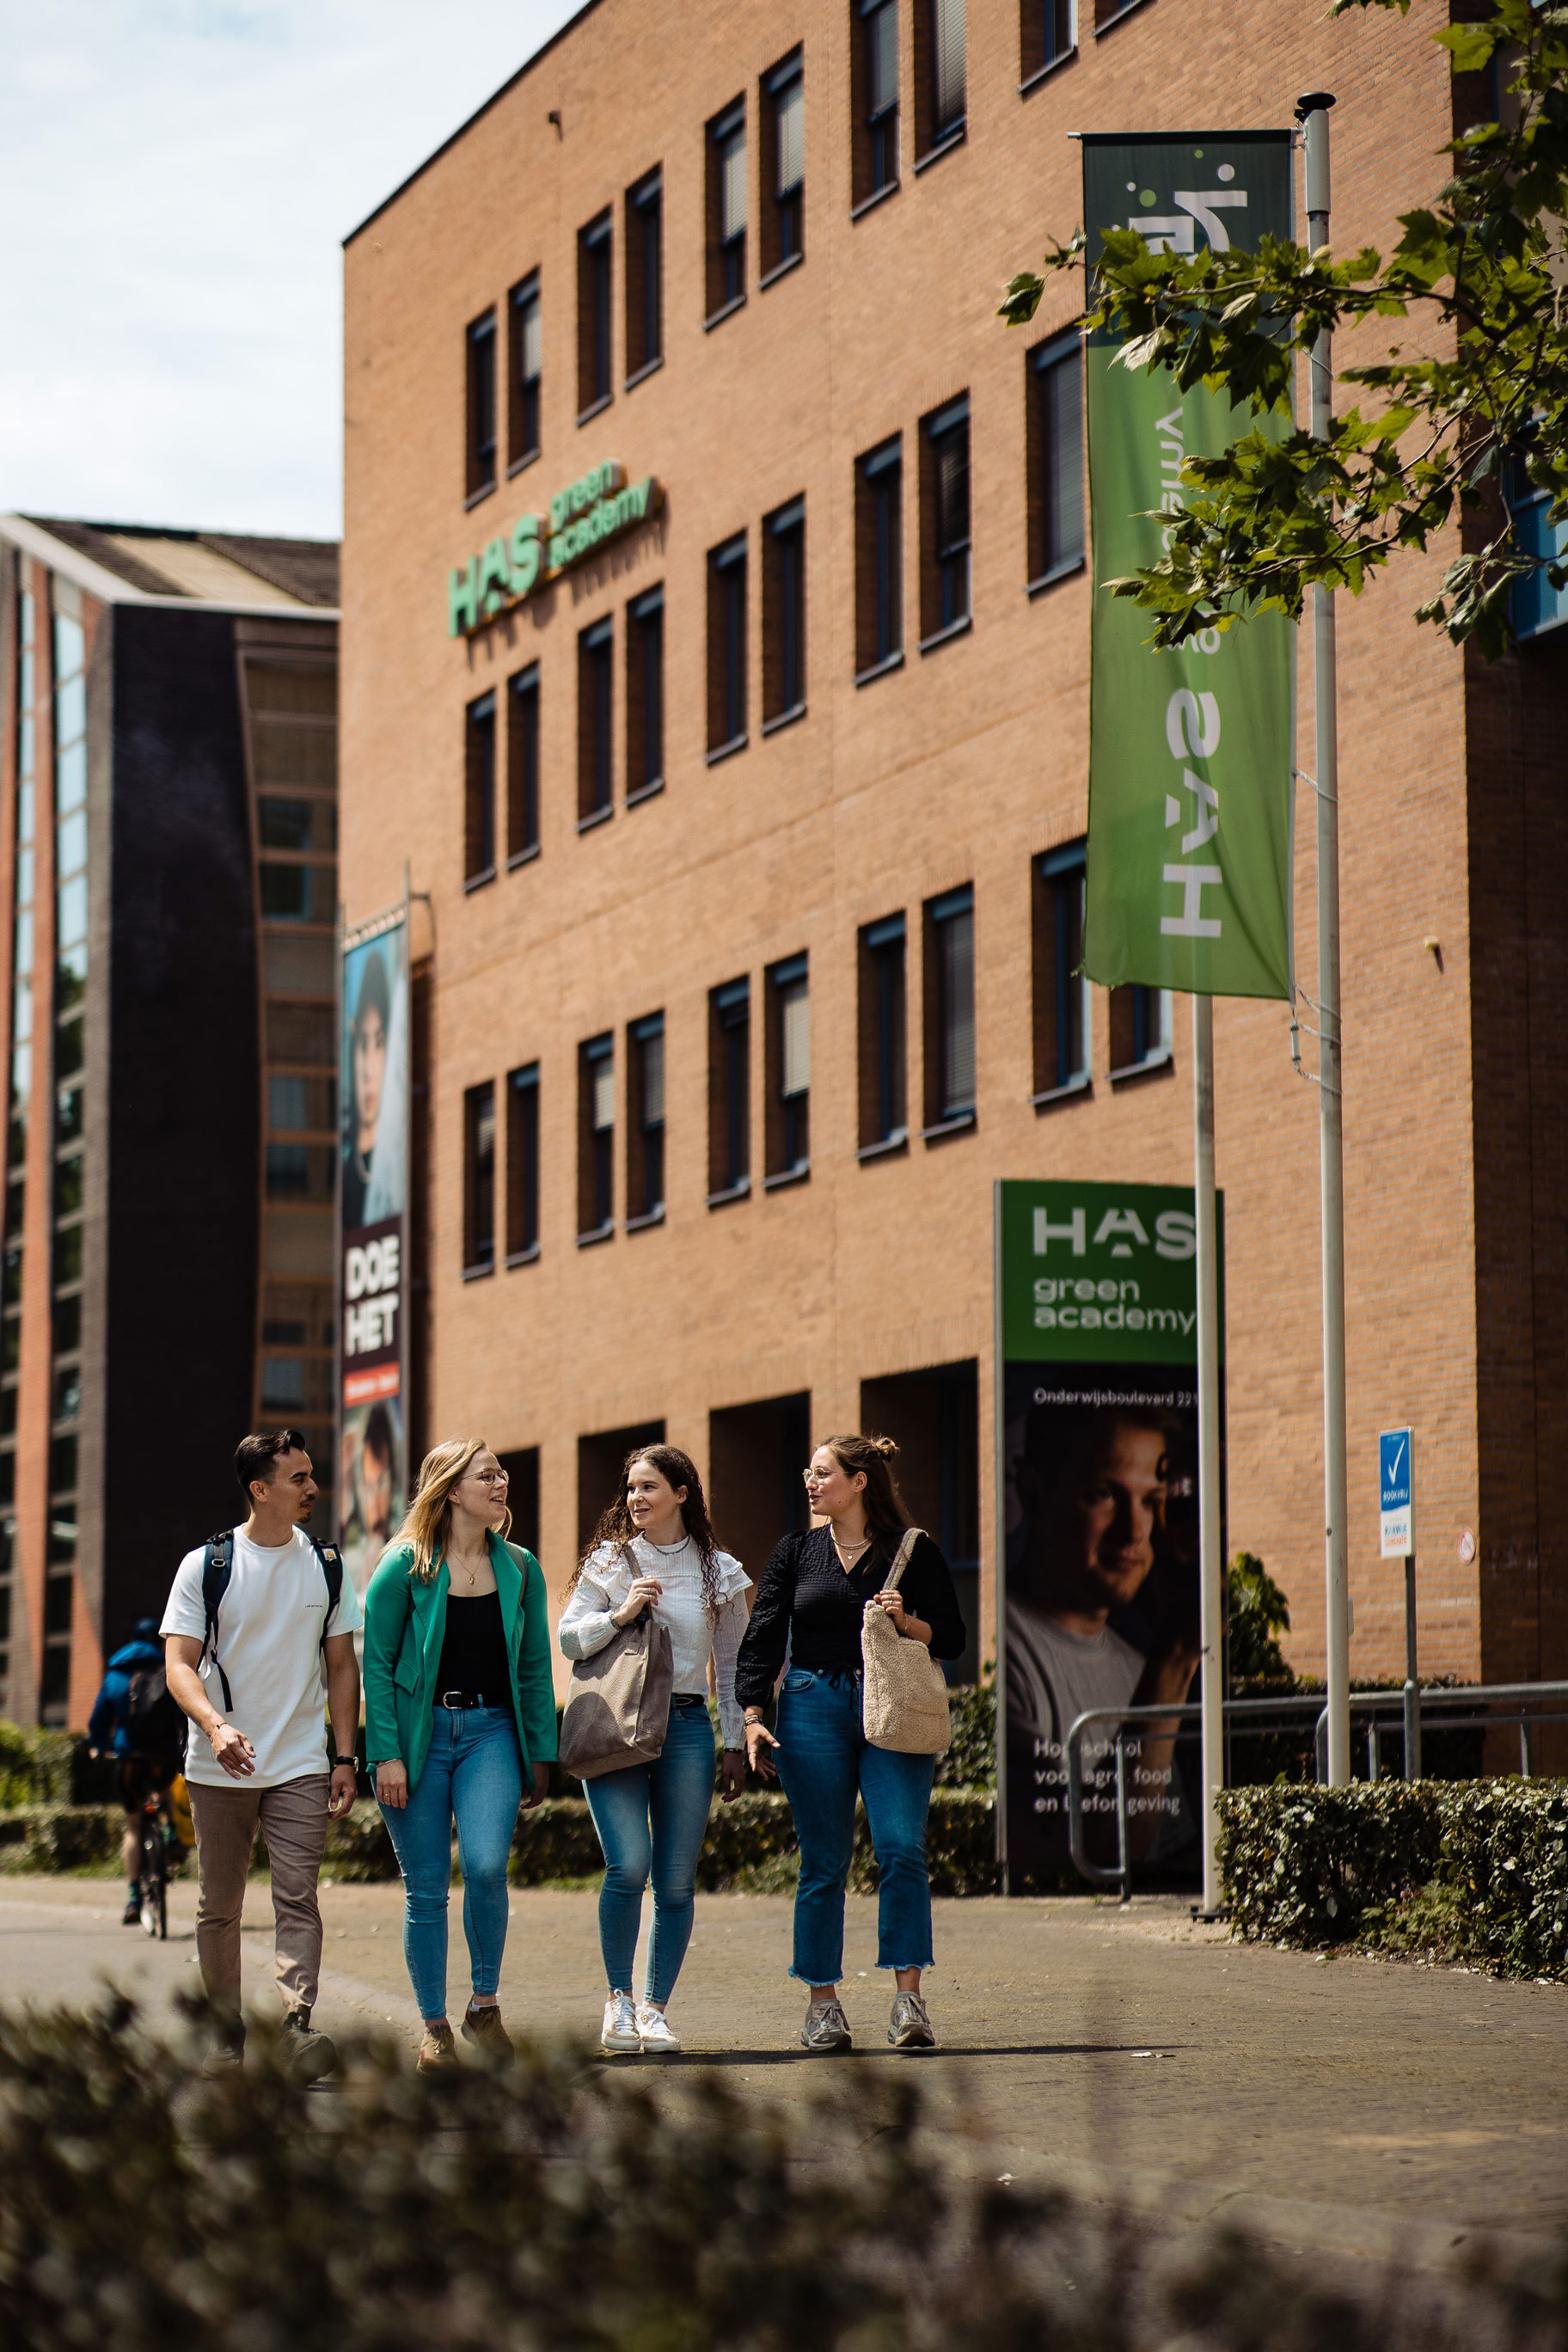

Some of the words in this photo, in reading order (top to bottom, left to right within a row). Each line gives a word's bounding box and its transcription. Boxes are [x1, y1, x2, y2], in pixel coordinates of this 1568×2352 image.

[548, 458, 616, 534] green
[548, 475, 653, 569] academy
[448, 512, 542, 638] HAS
[1033, 1206, 1197, 1261] HAS
[345, 1234, 399, 1302] DOE
[1034, 1277, 1141, 1304] green
[345, 1292, 399, 1357] HET
[1033, 1302, 1197, 1336] academy
[1033, 1387, 1174, 1408] Onderwijsboulevard
[1382, 1487, 1409, 1503] ROOKVRIJ
[1034, 1770, 1072, 1785] voo
[1133, 1765, 1173, 1785] food
[1033, 1797, 1058, 1814] en
